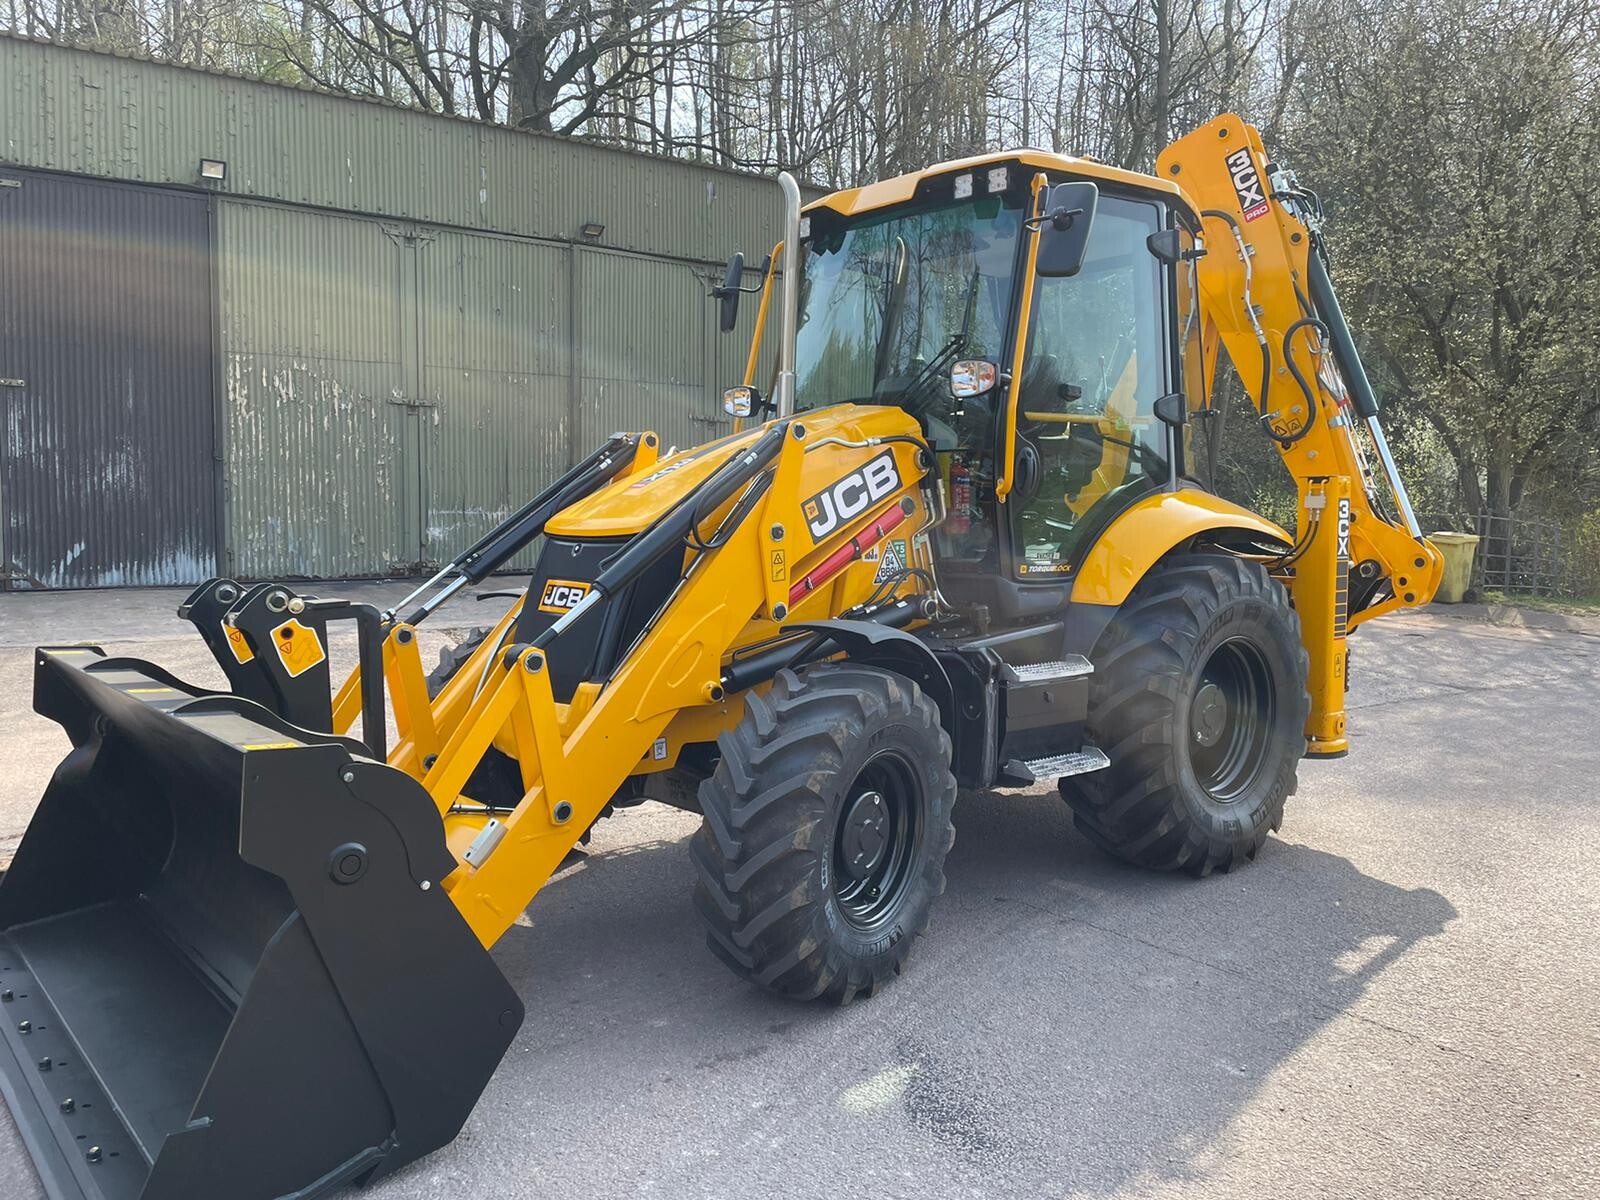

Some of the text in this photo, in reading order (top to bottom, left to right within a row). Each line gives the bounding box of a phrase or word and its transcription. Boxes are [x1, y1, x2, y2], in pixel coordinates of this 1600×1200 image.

[1228, 150, 1265, 209] 3CX
[1246, 205, 1268, 220] PRO
[811, 455, 898, 537] JCB
[1337, 500, 1349, 556] 3CX
[1028, 565, 1072, 573] TORQUELOCK
[544, 586, 584, 607] JCB
